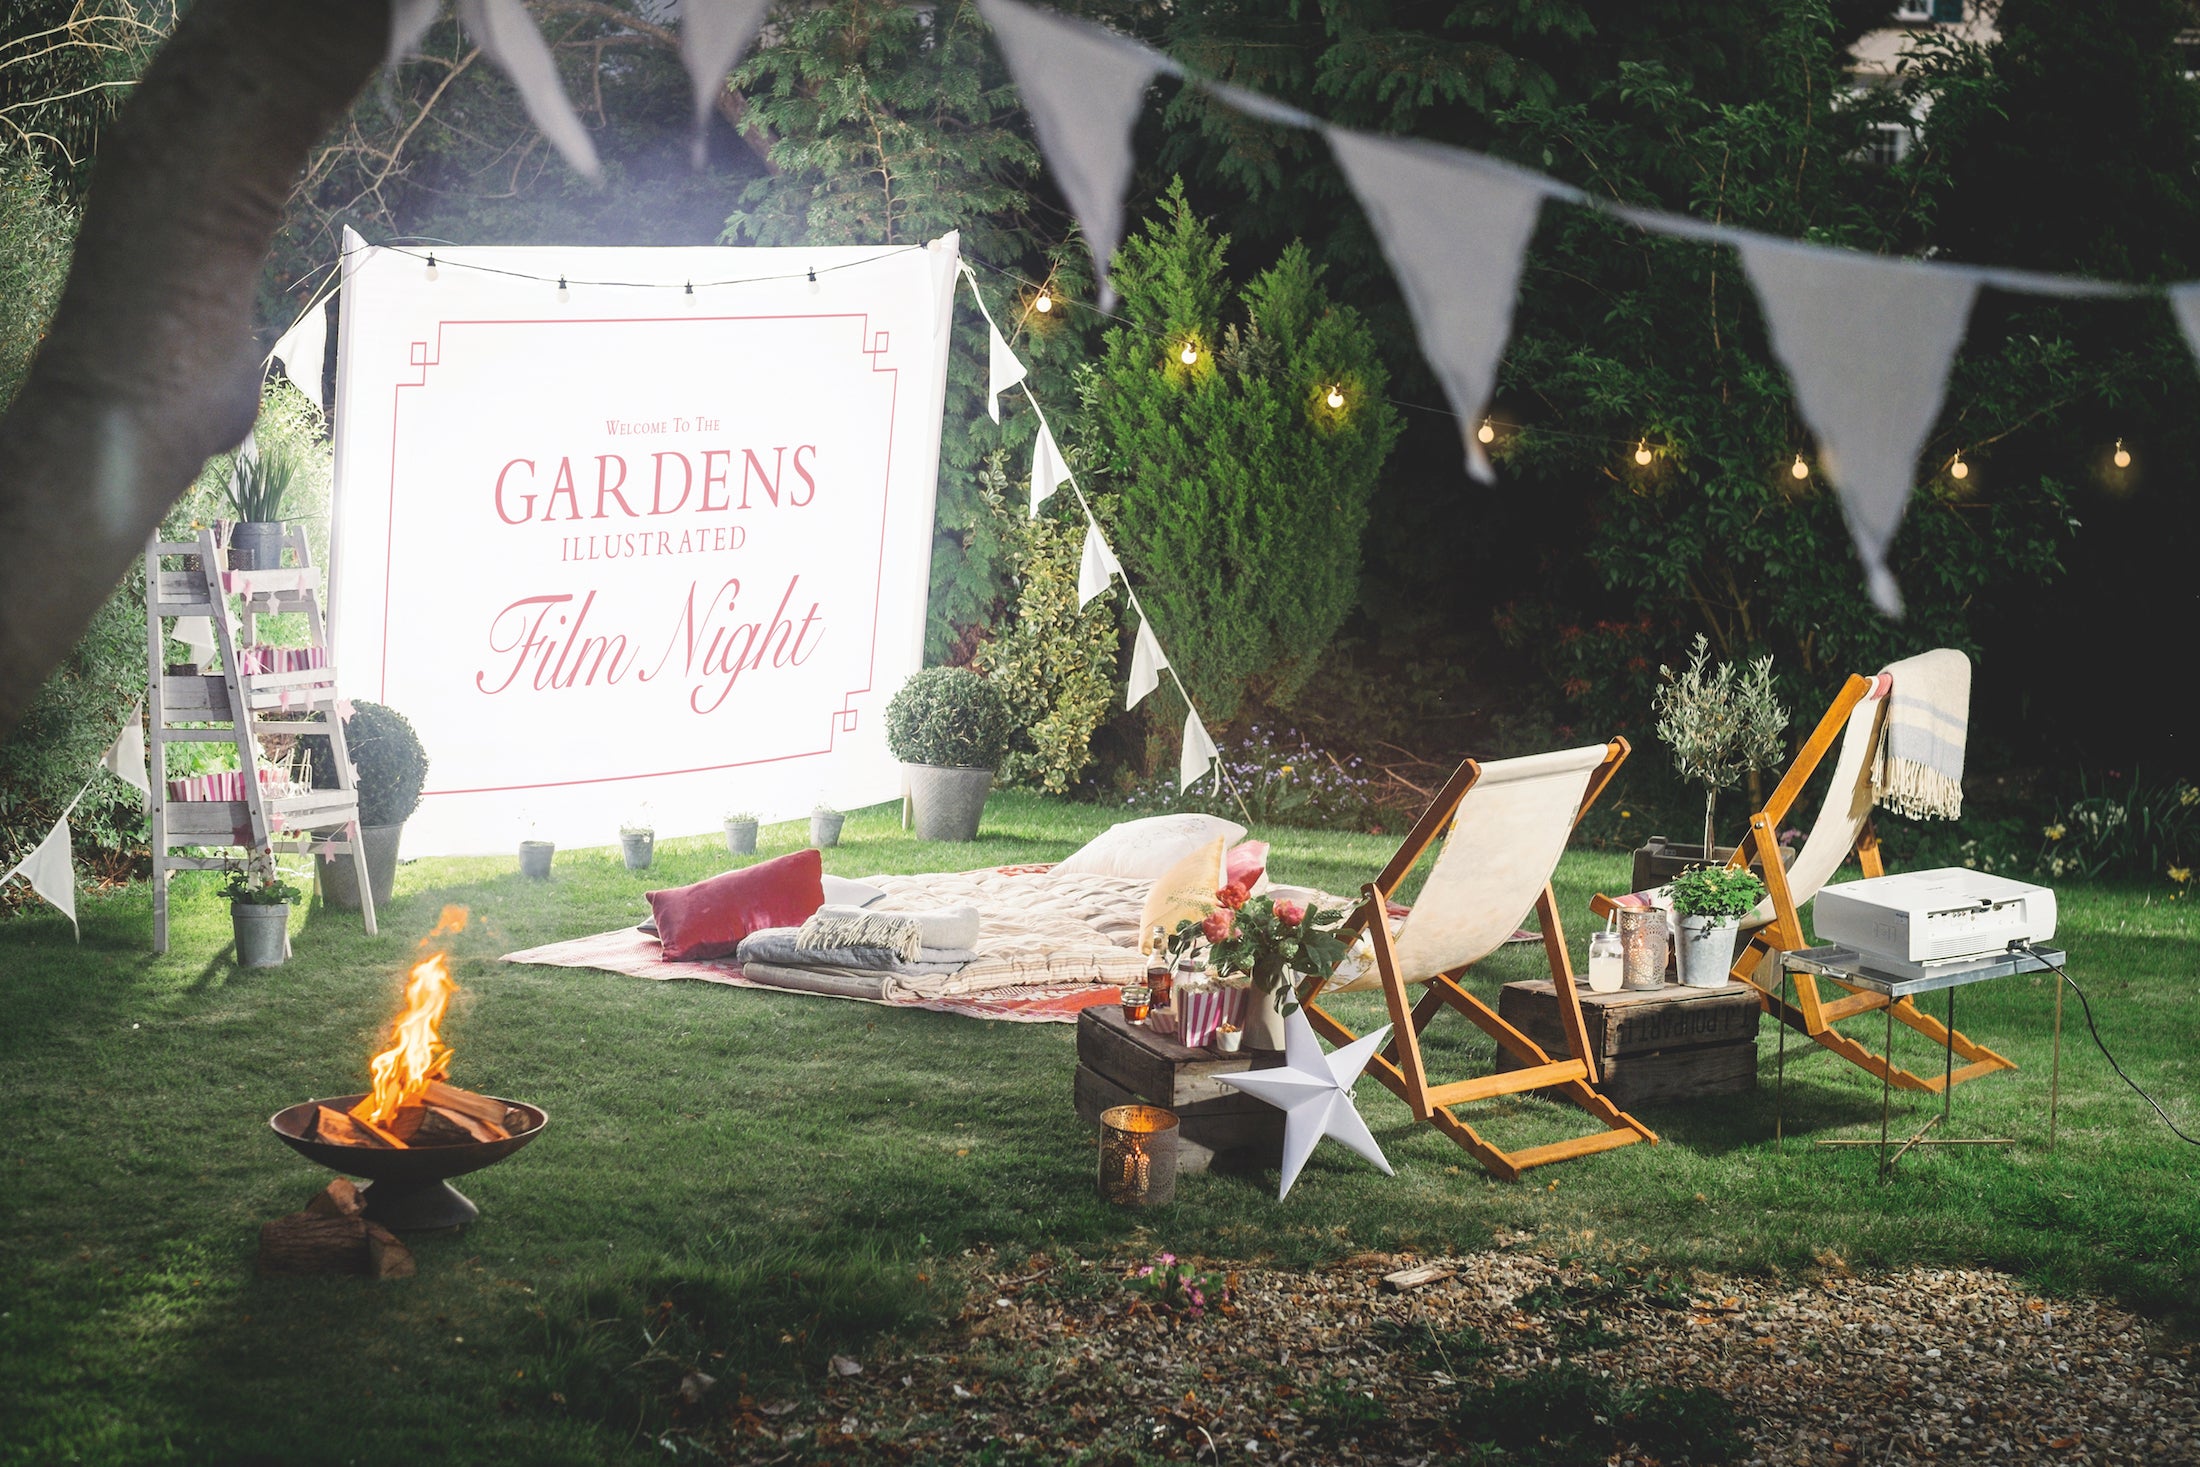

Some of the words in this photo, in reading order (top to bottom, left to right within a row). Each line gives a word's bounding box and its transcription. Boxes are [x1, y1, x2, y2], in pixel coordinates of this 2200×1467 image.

[495, 444, 817, 525] GARDENS
[561, 525, 747, 562] ILLUSTRATED
[476, 590, 641, 695] Film
[638, 574, 827, 715] Night
